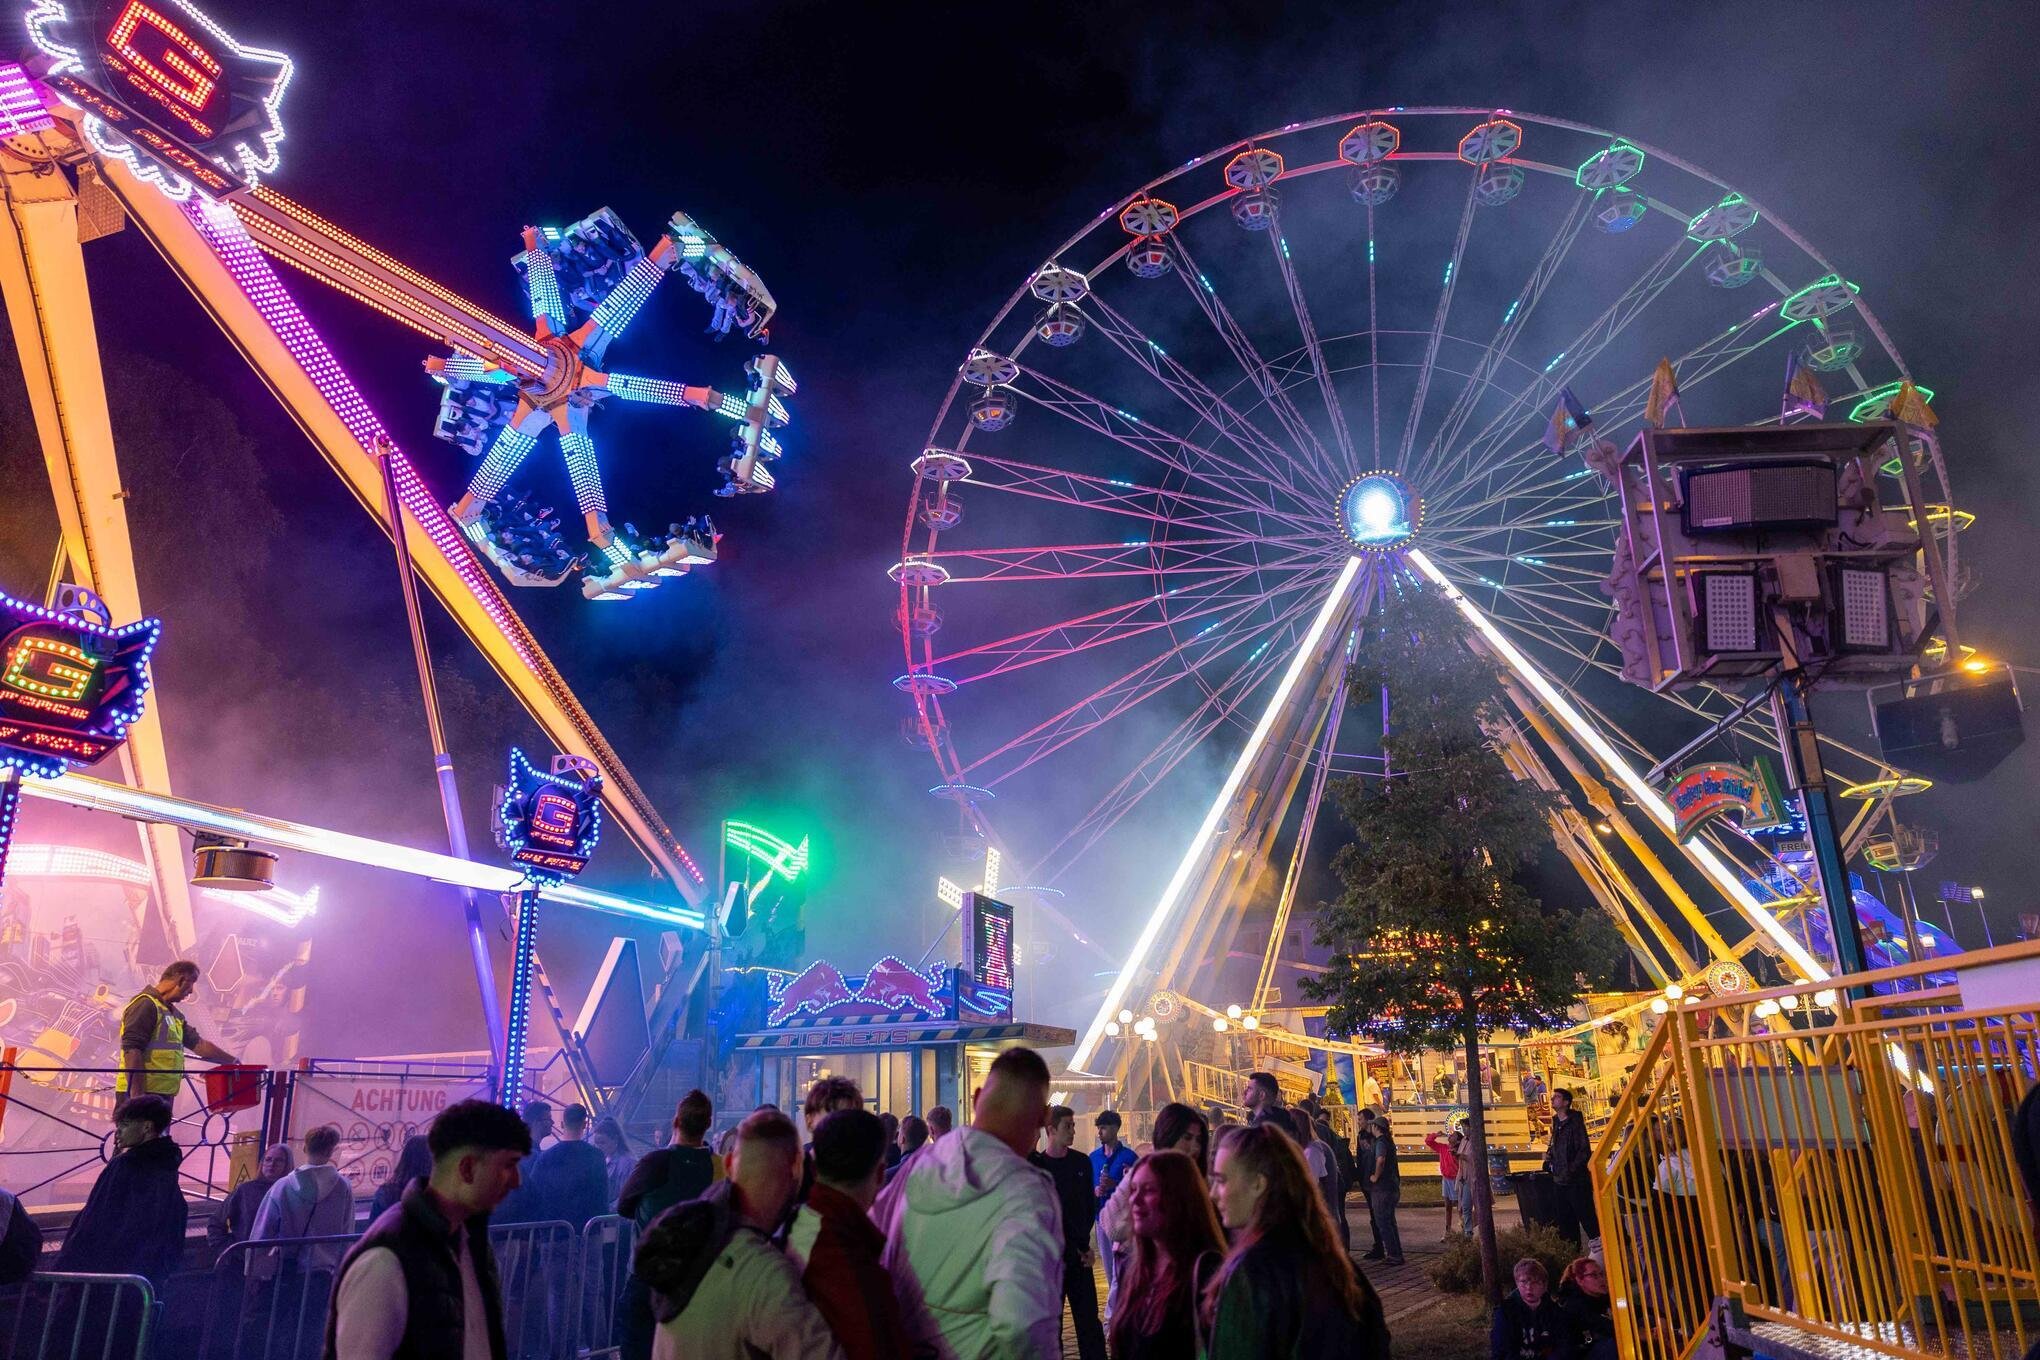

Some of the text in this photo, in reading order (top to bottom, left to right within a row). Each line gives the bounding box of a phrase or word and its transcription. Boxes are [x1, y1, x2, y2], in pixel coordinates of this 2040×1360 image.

[107, 0, 222, 112] G
[2, 636, 98, 701] G
[533, 794, 577, 835] G
[530, 830, 575, 847] FORCE
[780, 1028, 911, 1048] TICKETS
[351, 1087, 447, 1113] ACHTUNG
